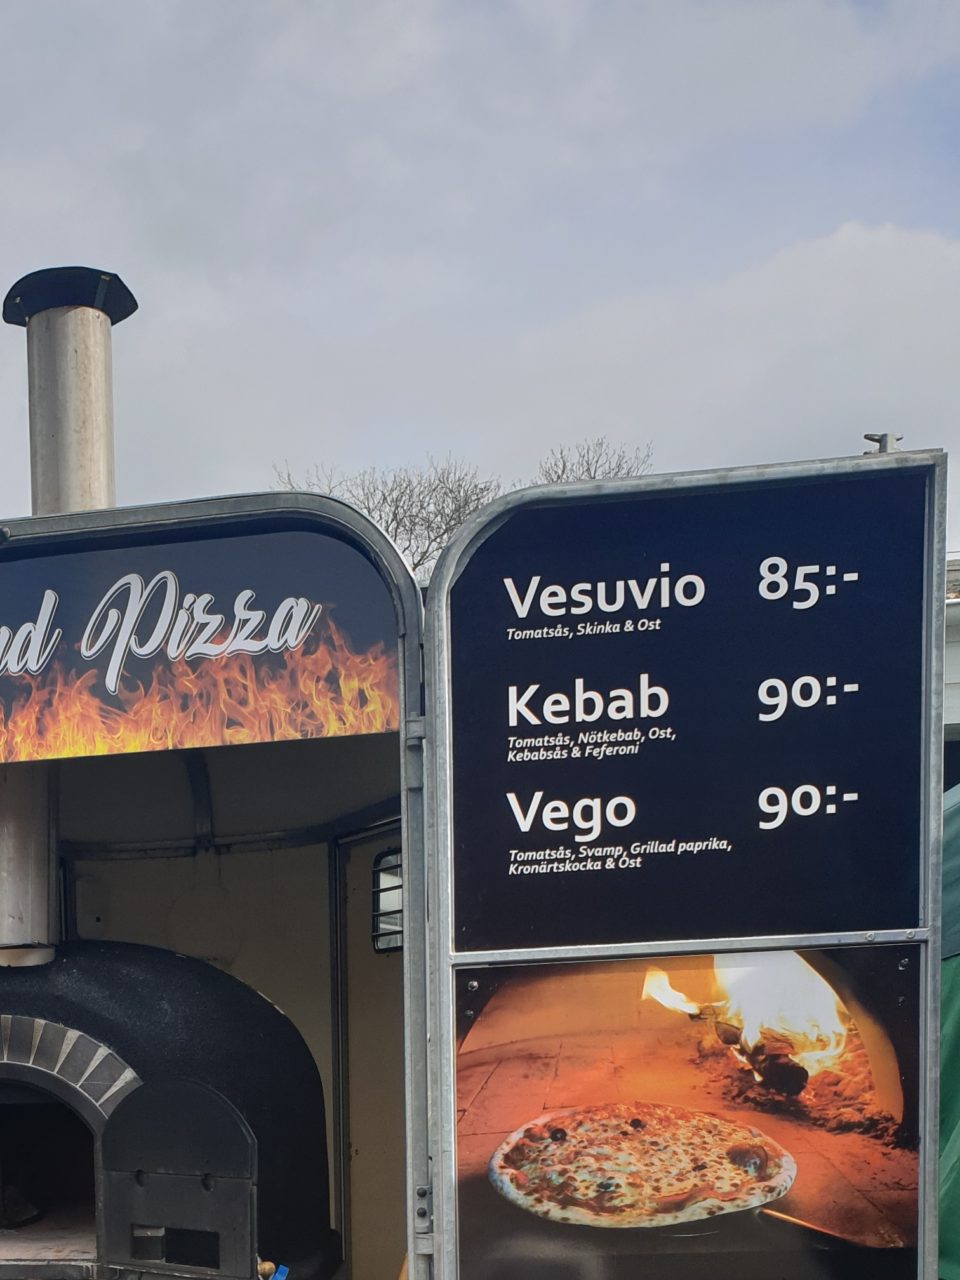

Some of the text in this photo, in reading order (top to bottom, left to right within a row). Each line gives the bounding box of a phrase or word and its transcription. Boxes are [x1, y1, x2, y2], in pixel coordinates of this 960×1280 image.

[504, 556, 859, 618] Vesuvio 85:-
[80, 570, 323, 695] Pizza
[507, 618, 661, 640] Tomatsås, Skinka & Ost
[508, 673, 859, 727] Kebab 90:-
[508, 727, 676, 750] Tomatsås, Nötkebab, Ost,
[507, 742, 639, 762] Kebabsås & Feferoni
[505, 784, 858, 842] Vego 90:-
[509, 838, 732, 862] Tomatsås, Svamp, Grillad paprika,
[509, 856, 642, 875] Kronärtskocka & Ost
